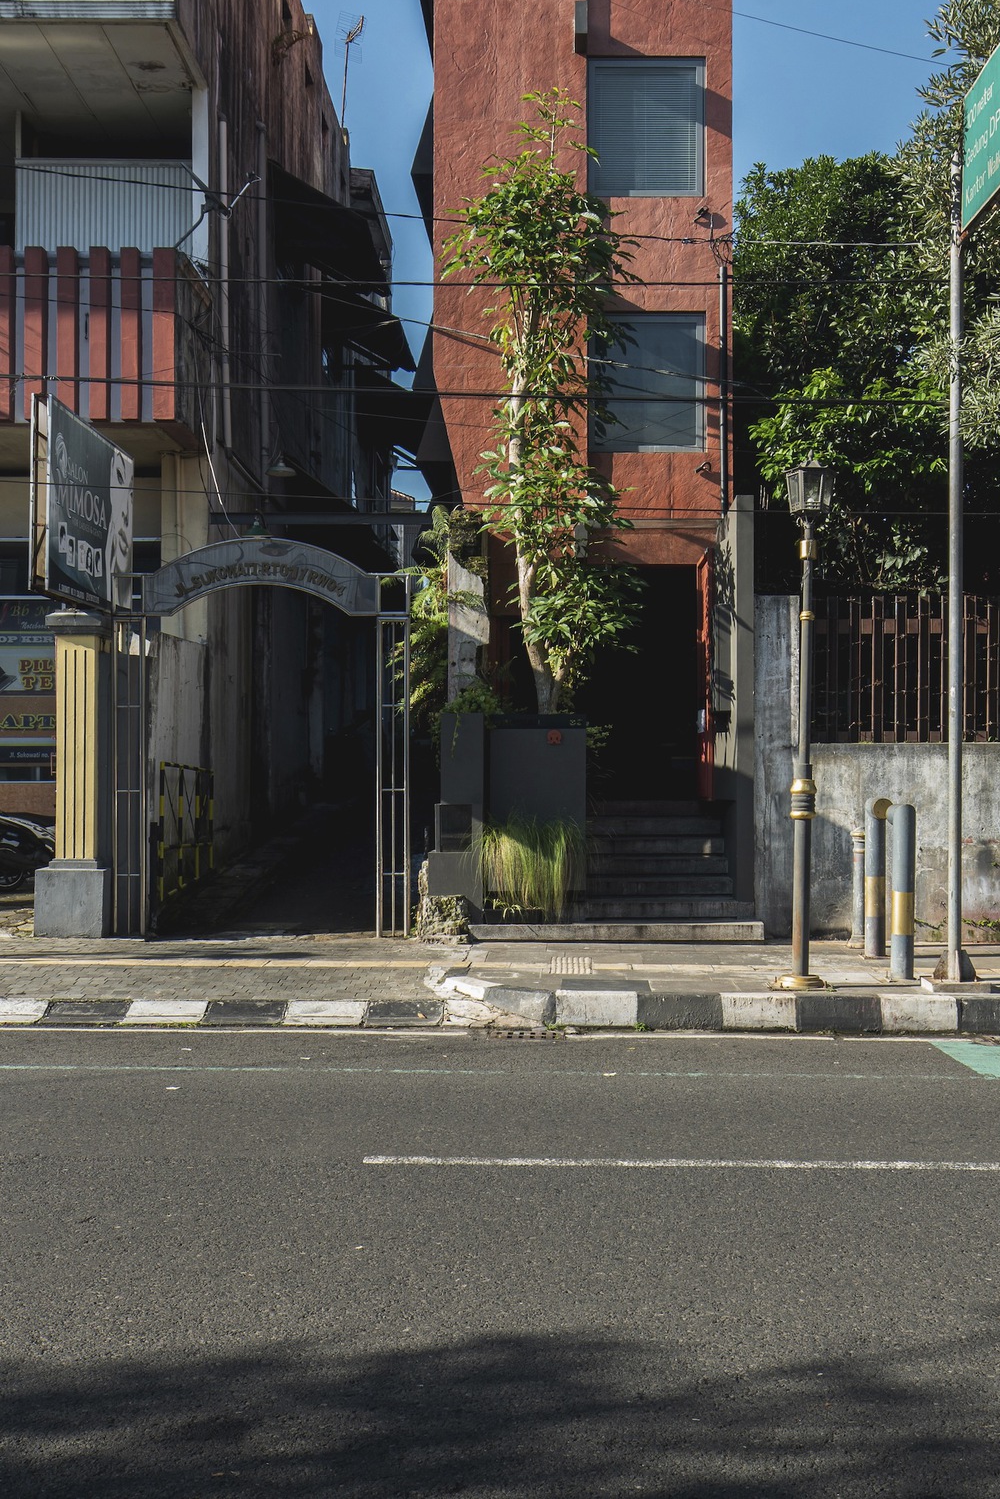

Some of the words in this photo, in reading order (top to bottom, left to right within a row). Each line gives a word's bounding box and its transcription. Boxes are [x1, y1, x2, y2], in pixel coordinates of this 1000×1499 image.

[977, 81, 994, 117] meter
[966, 130, 989, 168] Gedung
[965, 170, 987, 207] Kantor
[68, 457, 88, 485] SALON
[56, 468, 108, 531] MIMOSA
[19, 659, 56, 673] PIL
